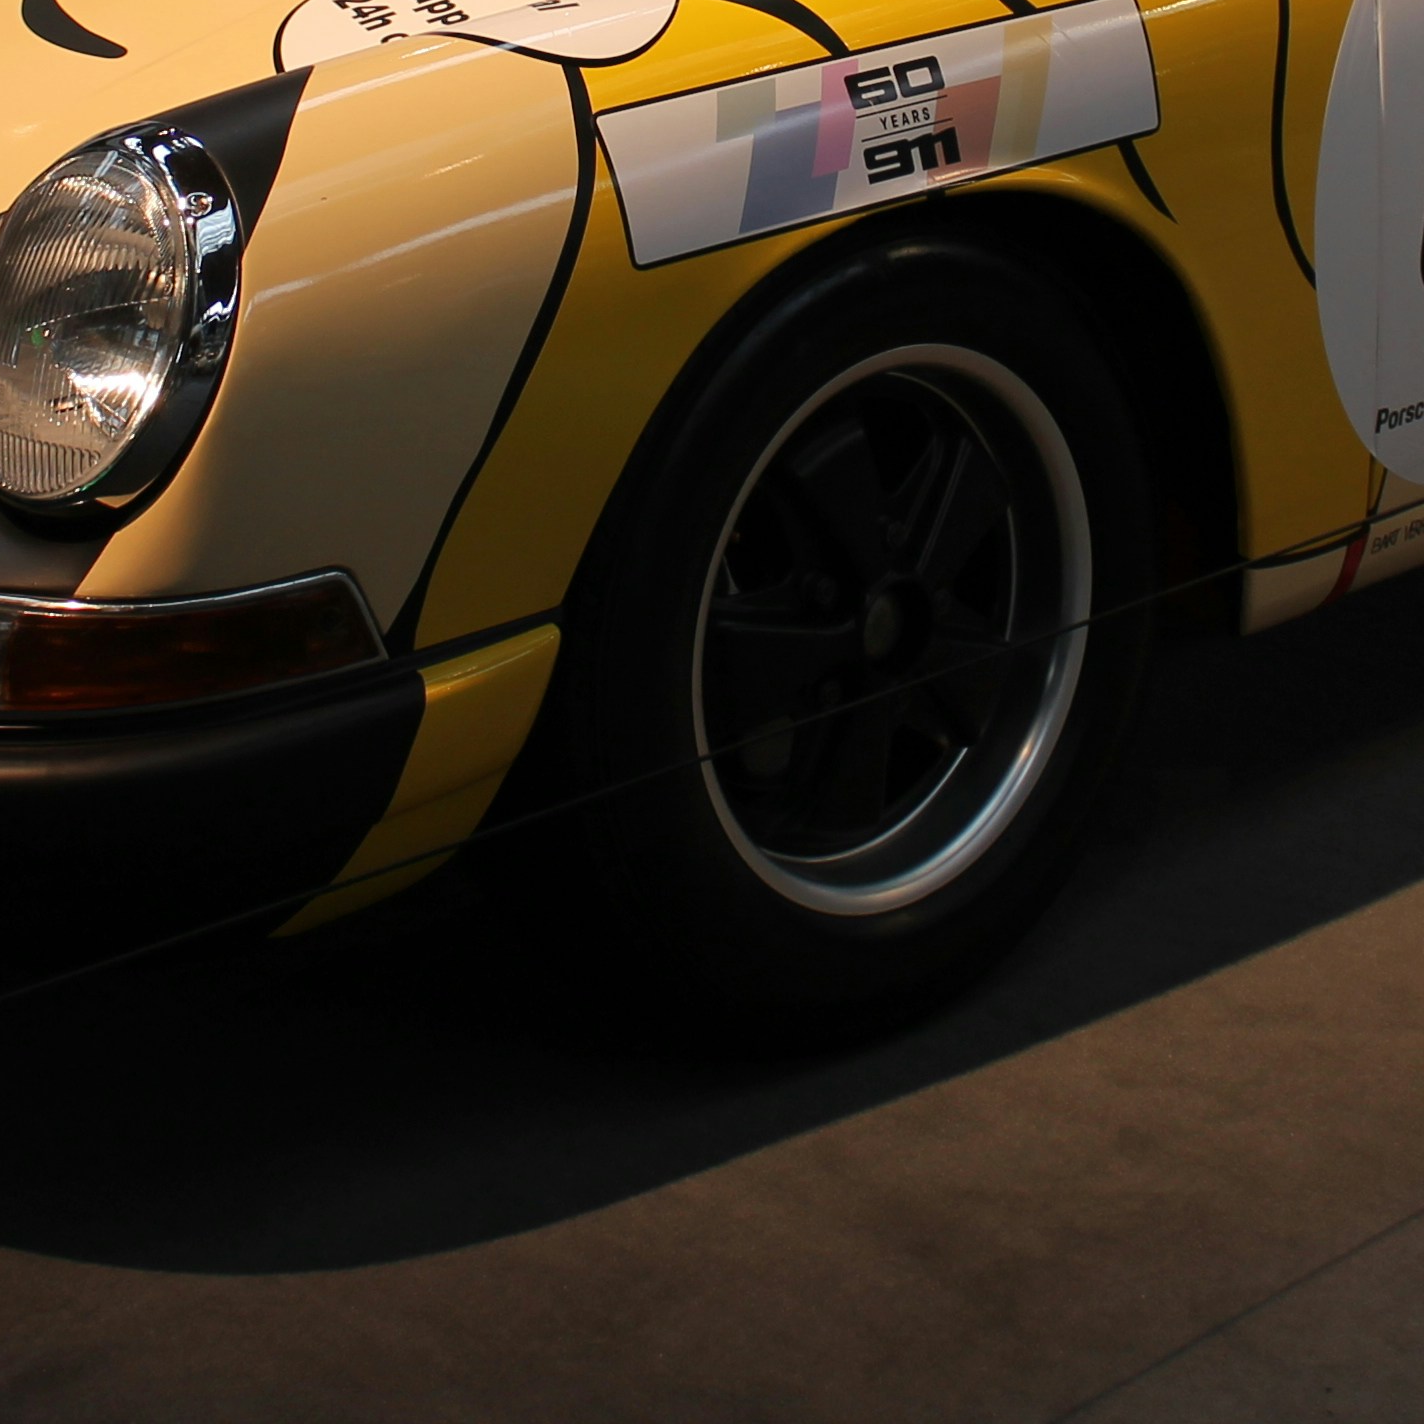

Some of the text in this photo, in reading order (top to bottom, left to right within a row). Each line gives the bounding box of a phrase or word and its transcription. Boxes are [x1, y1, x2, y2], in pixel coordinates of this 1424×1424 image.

[844, 55, 945, 111] 60
[879, 107, 931, 130] YEARS
[864, 126, 962, 185] 911
